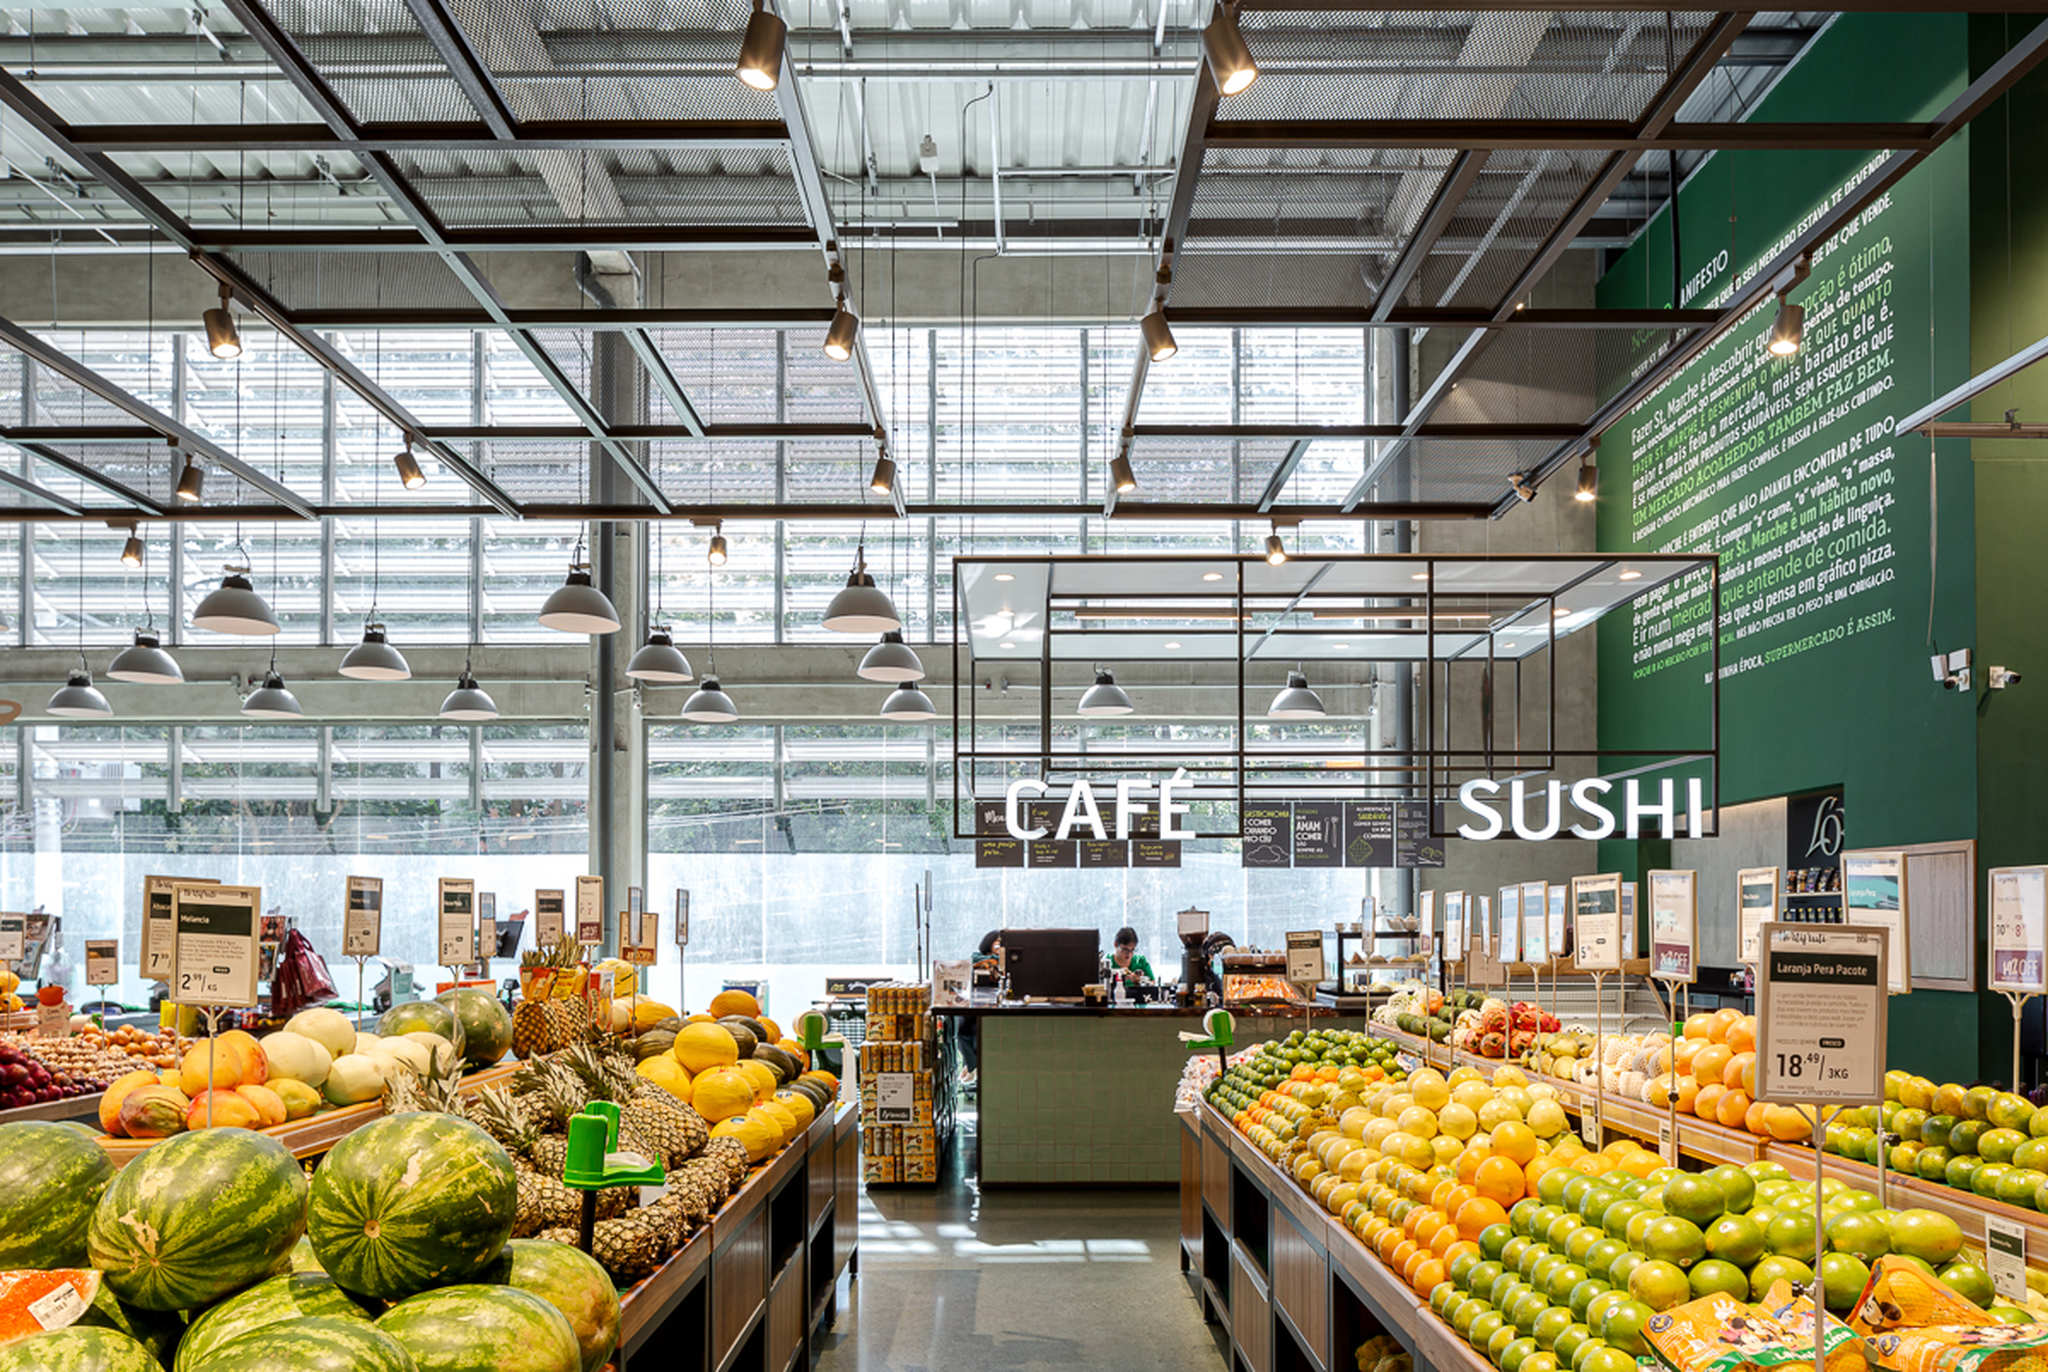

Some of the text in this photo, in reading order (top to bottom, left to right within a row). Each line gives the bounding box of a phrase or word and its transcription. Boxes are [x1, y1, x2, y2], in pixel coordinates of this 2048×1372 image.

[1797, 200, 1828, 236] ESTAVA
[1840, 216, 1859, 243] QUE
[1861, 192, 1892, 225] VENDE.
[1631, 419, 1652, 445] Fazer
[1667, 383, 1698, 417] Marche
[1700, 372, 1706, 392] é
[1708, 339, 1753, 386] descobrir
[1837, 264, 1845, 287] é
[1849, 236, 1892, 278] ótimo,
[1708, 376, 1756, 421] DESMENTIR
[1760, 369, 1766, 384] O
[1815, 317, 1837, 344] QUE
[1842, 279, 1891, 325] QUANTO
[1741, 361, 1752, 377] de
[1803, 301, 1834, 337] perda
[1836, 289, 1850, 308] de
[1853, 261, 1893, 295] tempo.
[1658, 462, 1662, 474] e
[1665, 445, 1686, 469] mais
[1688, 430, 1707, 453] feio
[1710, 424, 1716, 438] o
[1719, 390, 1768, 432] mercado,
[1772, 365, 1800, 396] mais
[1805, 333, 1848, 373] barato
[1853, 313, 1874, 340] ele
[1880, 298, 1893, 321] é.
[1742, 393, 1792, 435] SAUDÁVEIS,
[1795, 376, 1813, 400] SEM
[1817, 341, 1867, 386] ESQUECER
[1871, 323, 1893, 350] QUE
[1632, 348, 1893, 525] UM MERCADO ACOLHEDOR TAMBÉM FAZ BEM.
[1721, 503, 1736, 525] QUE
[1738, 493, 1757, 515] NÃO
[1793, 442, 1847, 484] ENCONTRAR
[1849, 432, 1861, 452] DE
[1865, 415, 1894, 444] TUDO
[1858, 446, 1894, 473] massa,
[1736, 539, 1749, 557] St.
[1751, 520, 1787, 549] Marche
[1790, 511, 1797, 530] é
[1800, 506, 1816, 525] um
[1819, 486, 1857, 515] hábito
[1860, 468, 1894, 495] novo,
[1784, 521, 1829, 555] encheção
[1832, 512, 1844, 531] de
[1847, 492, 1894, 524] linguiça.
[1648, 617, 1671, 638] num
[1672, 592, 1711, 627] mercad
[1720, 583, 1744, 609] que
[1746, 554, 1801, 594] entende
[1805, 542, 1824, 568] de
[1827, 511, 1890, 558] comida.
[1733, 603, 1750, 624] que
[1752, 593, 1763, 613] só
[1766, 584, 1795, 612] pensa
[1798, 576, 1814, 594] em
[1817, 558, 1855, 591] gráfico
[1859, 543, 1895, 574] pizza.
[1765, 625, 1843, 663] SUPERMERCADO
[1847, 617, 1853, 635] É
[1856, 608, 1895, 632] ASSIM.
[1006, 767, 1195, 840] CAFÉ
[1295, 832, 1322, 840] COMER
[1296, 821, 1321, 831] AMAM
[1456, 778, 1702, 841] SUSHI
[180, 914, 210, 924] Melancia
[1777, 962, 1868, 976] Laranja Pera Pacote
[1828, 1068, 1848, 1080] 3KG
